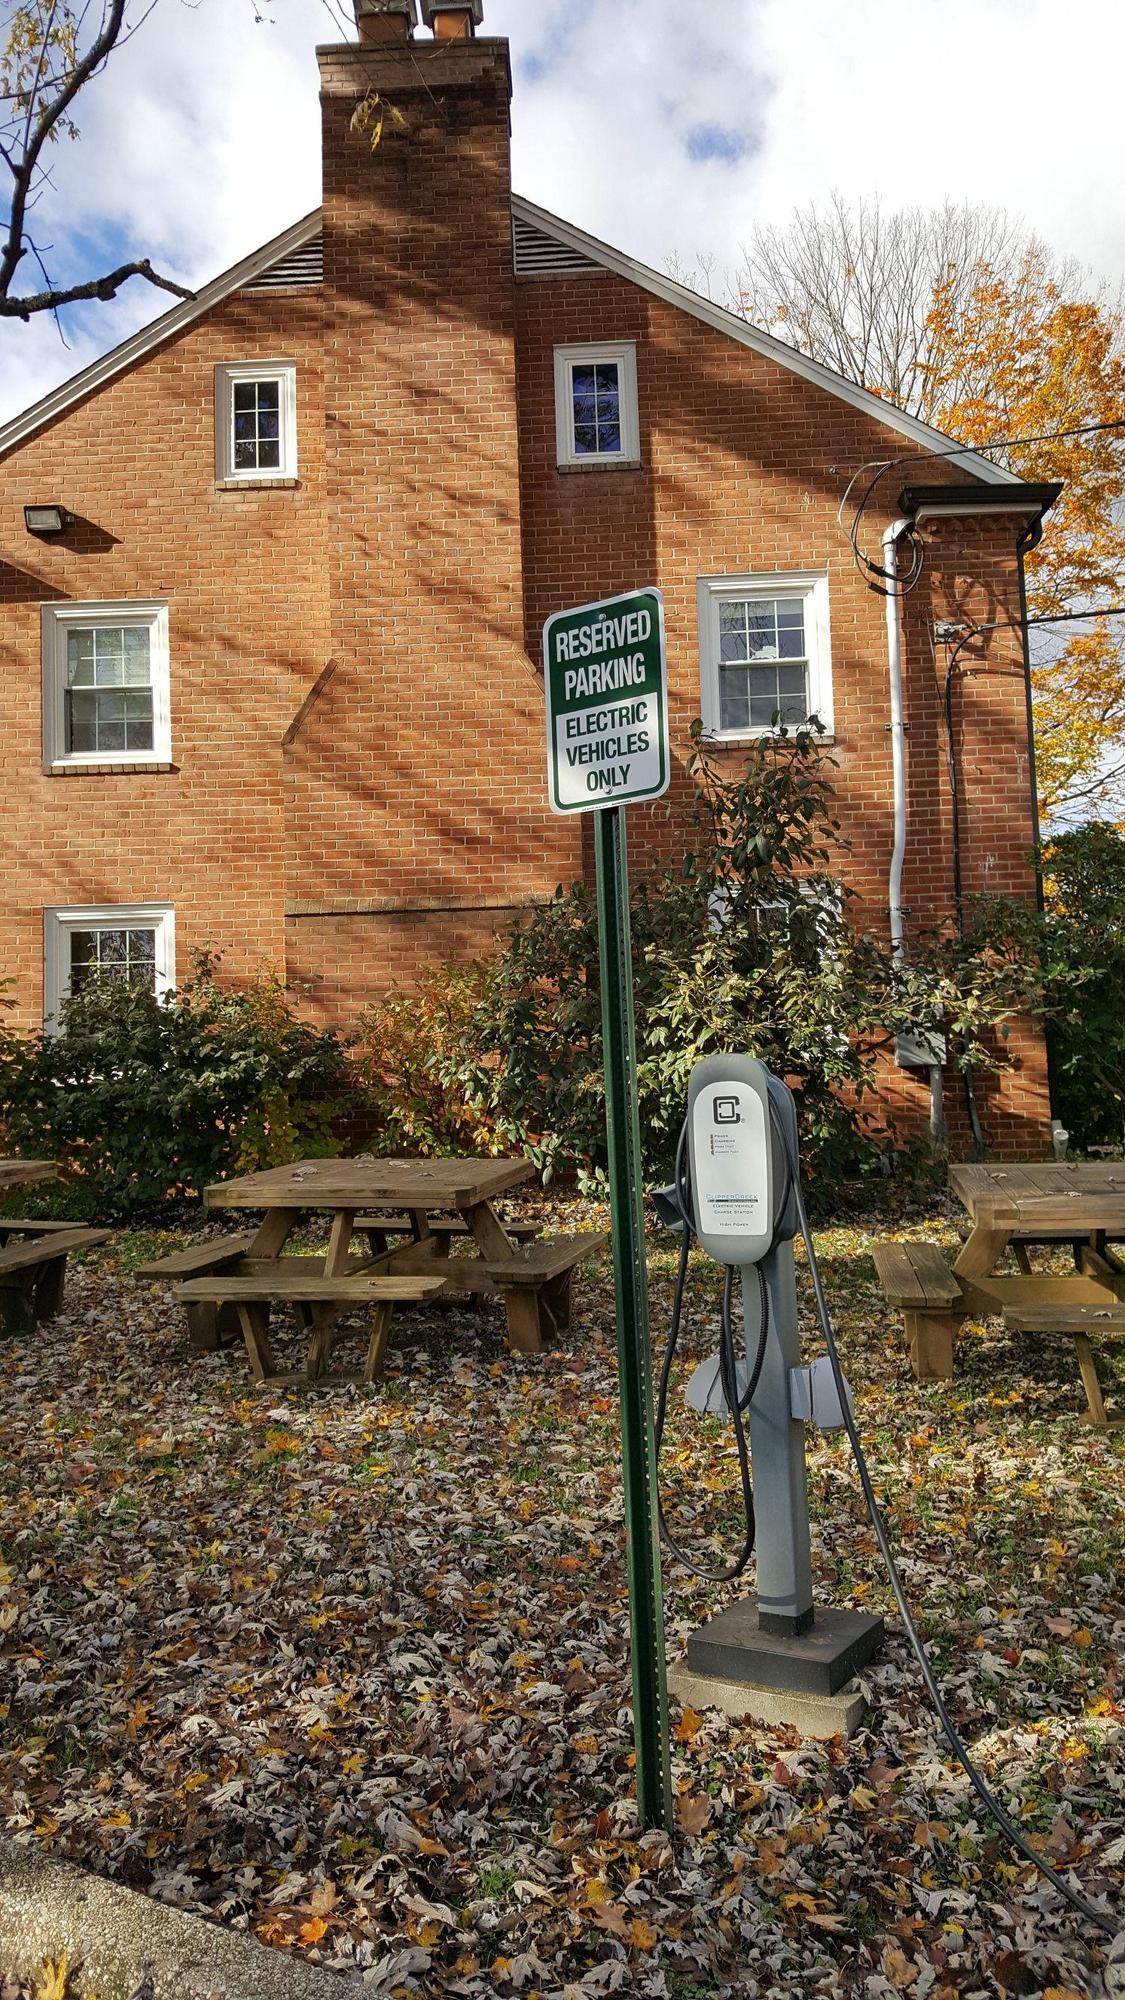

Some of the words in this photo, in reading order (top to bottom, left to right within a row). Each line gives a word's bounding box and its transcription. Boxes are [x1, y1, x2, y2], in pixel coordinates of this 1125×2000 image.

[555, 609, 651, 663] RESERVED
[564, 652, 646, 701] PARKING
[566, 701, 648, 739] ELECTRIC
[566, 730, 650, 767] VEHICLES
[586, 763, 631, 792] ONLY
